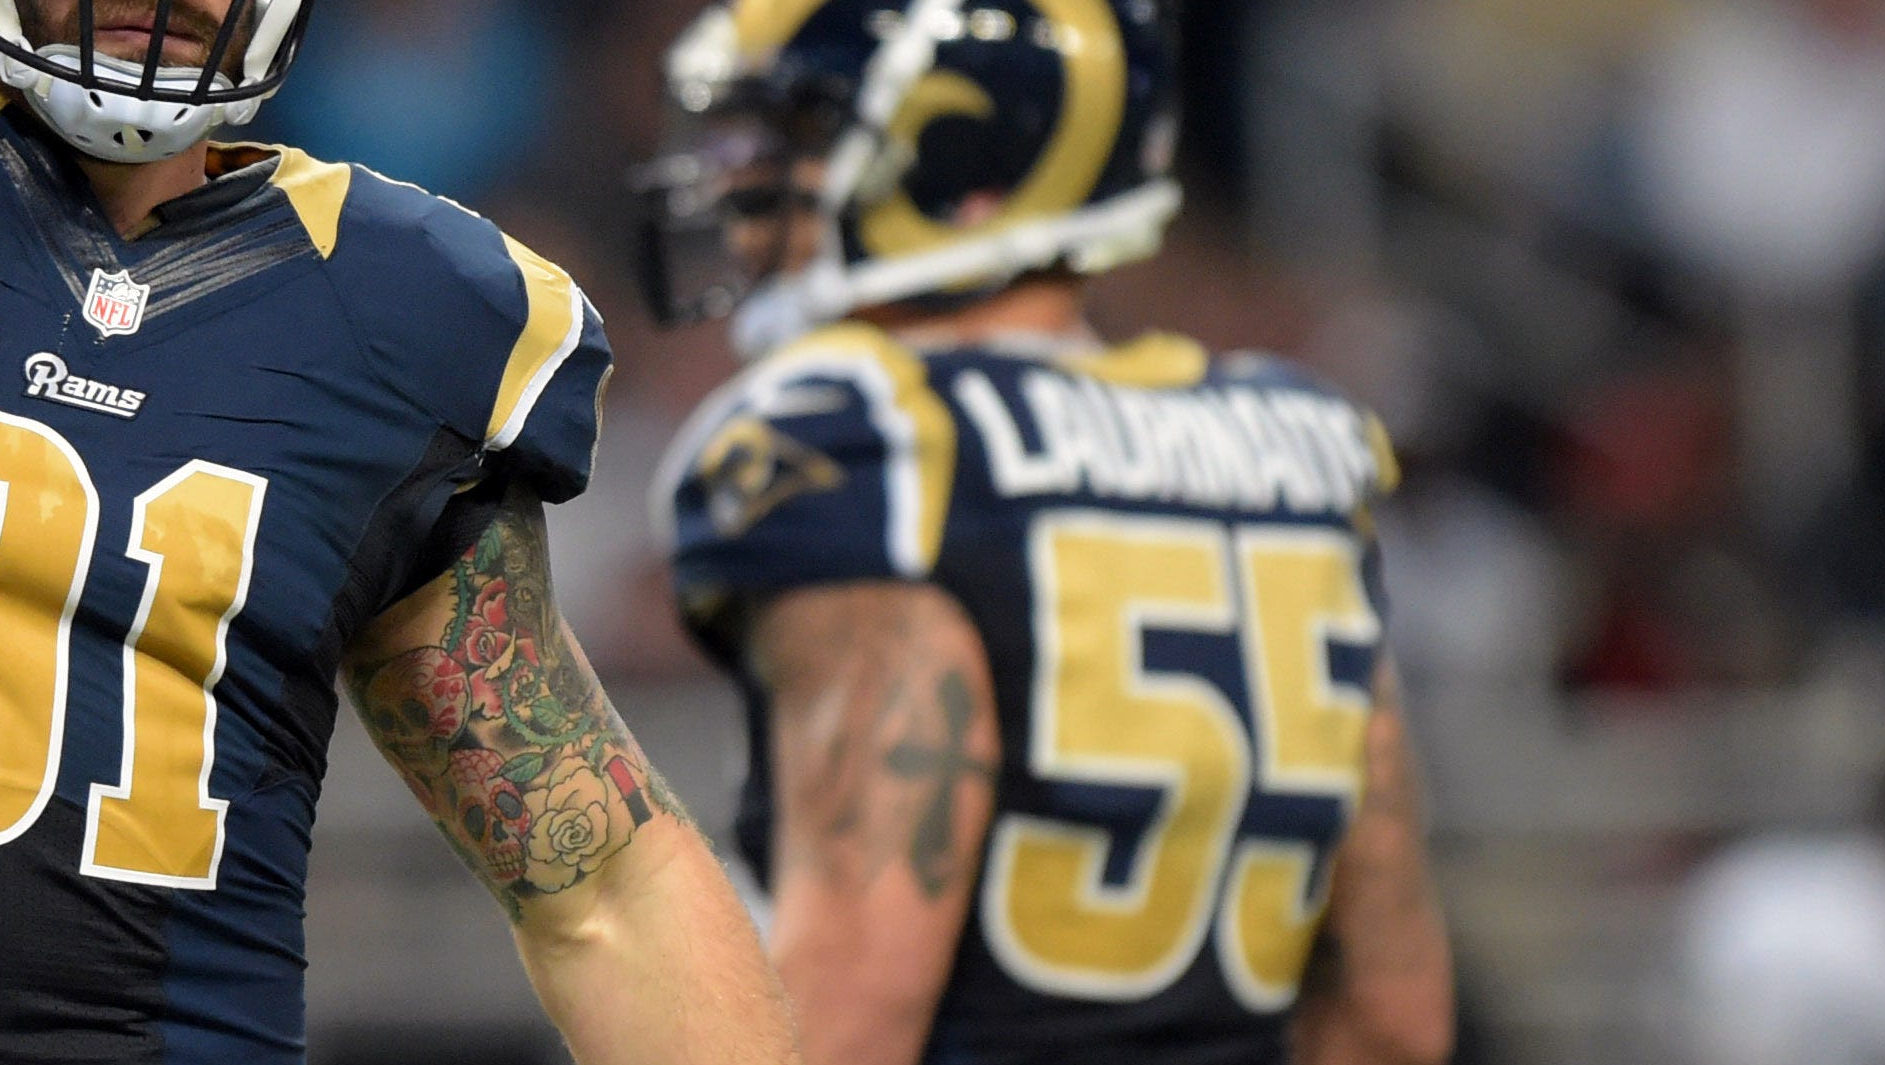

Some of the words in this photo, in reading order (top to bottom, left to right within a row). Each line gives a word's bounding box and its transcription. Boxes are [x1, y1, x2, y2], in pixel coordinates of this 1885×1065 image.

[92, 295, 131, 327] NFL
[24, 351, 147, 418] Rams
[979, 507, 1381, 1016] 55
